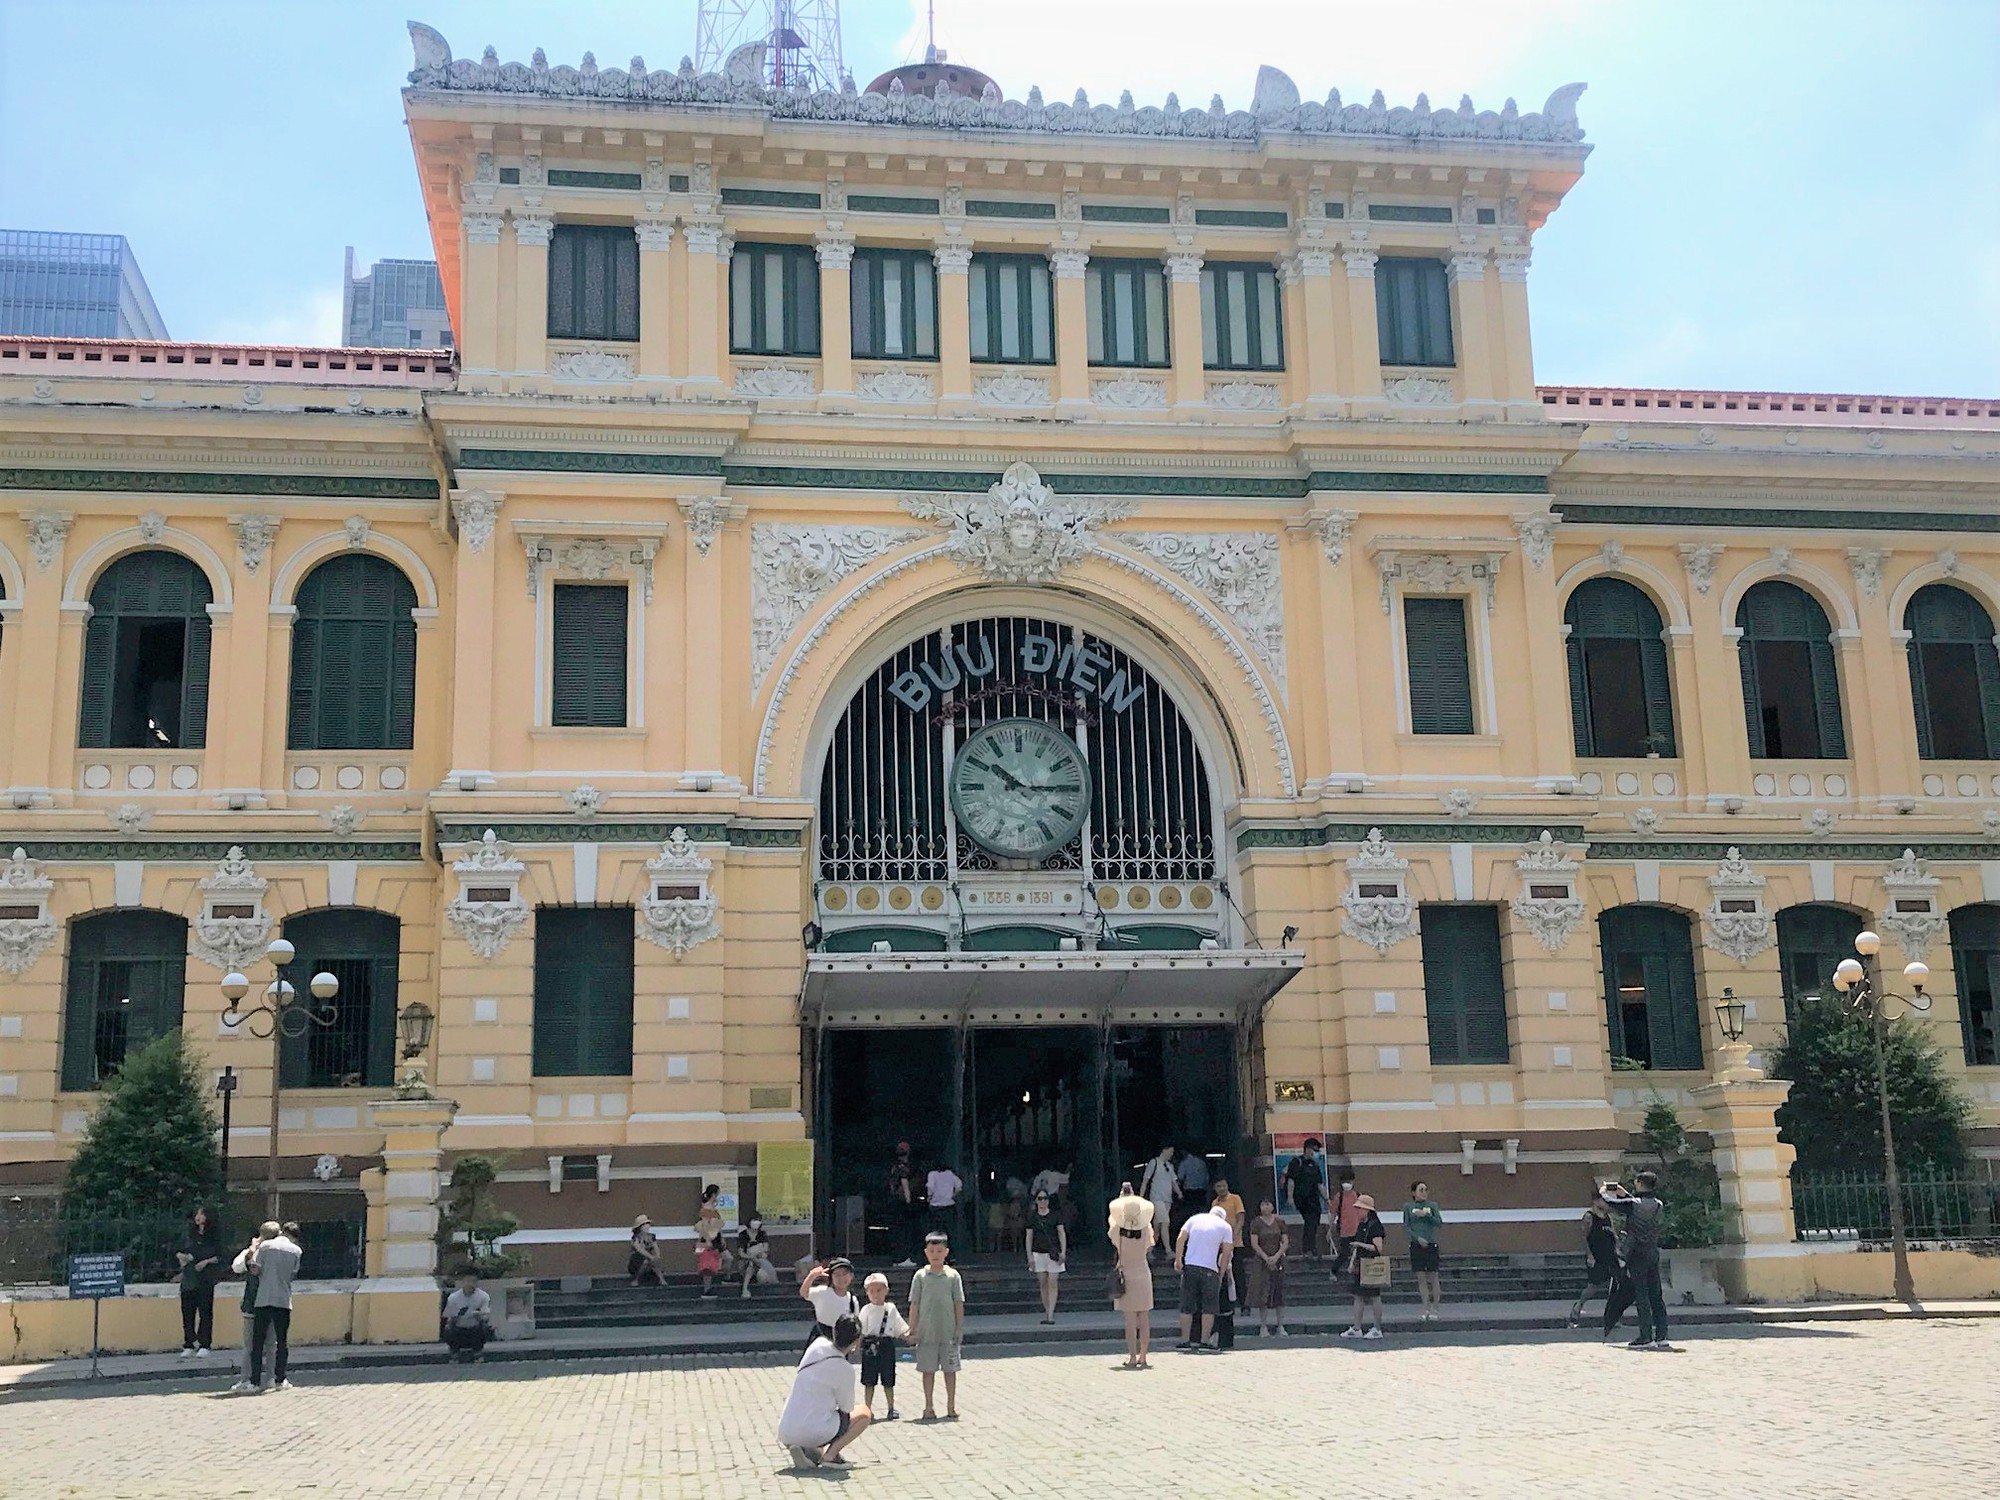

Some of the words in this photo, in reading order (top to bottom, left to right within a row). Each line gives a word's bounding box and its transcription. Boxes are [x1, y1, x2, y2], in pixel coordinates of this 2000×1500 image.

[1020, 634, 1145, 714] ĐIỆN
[983, 891, 1011, 904] 1886
[1029, 891, 1053, 904] 1891
